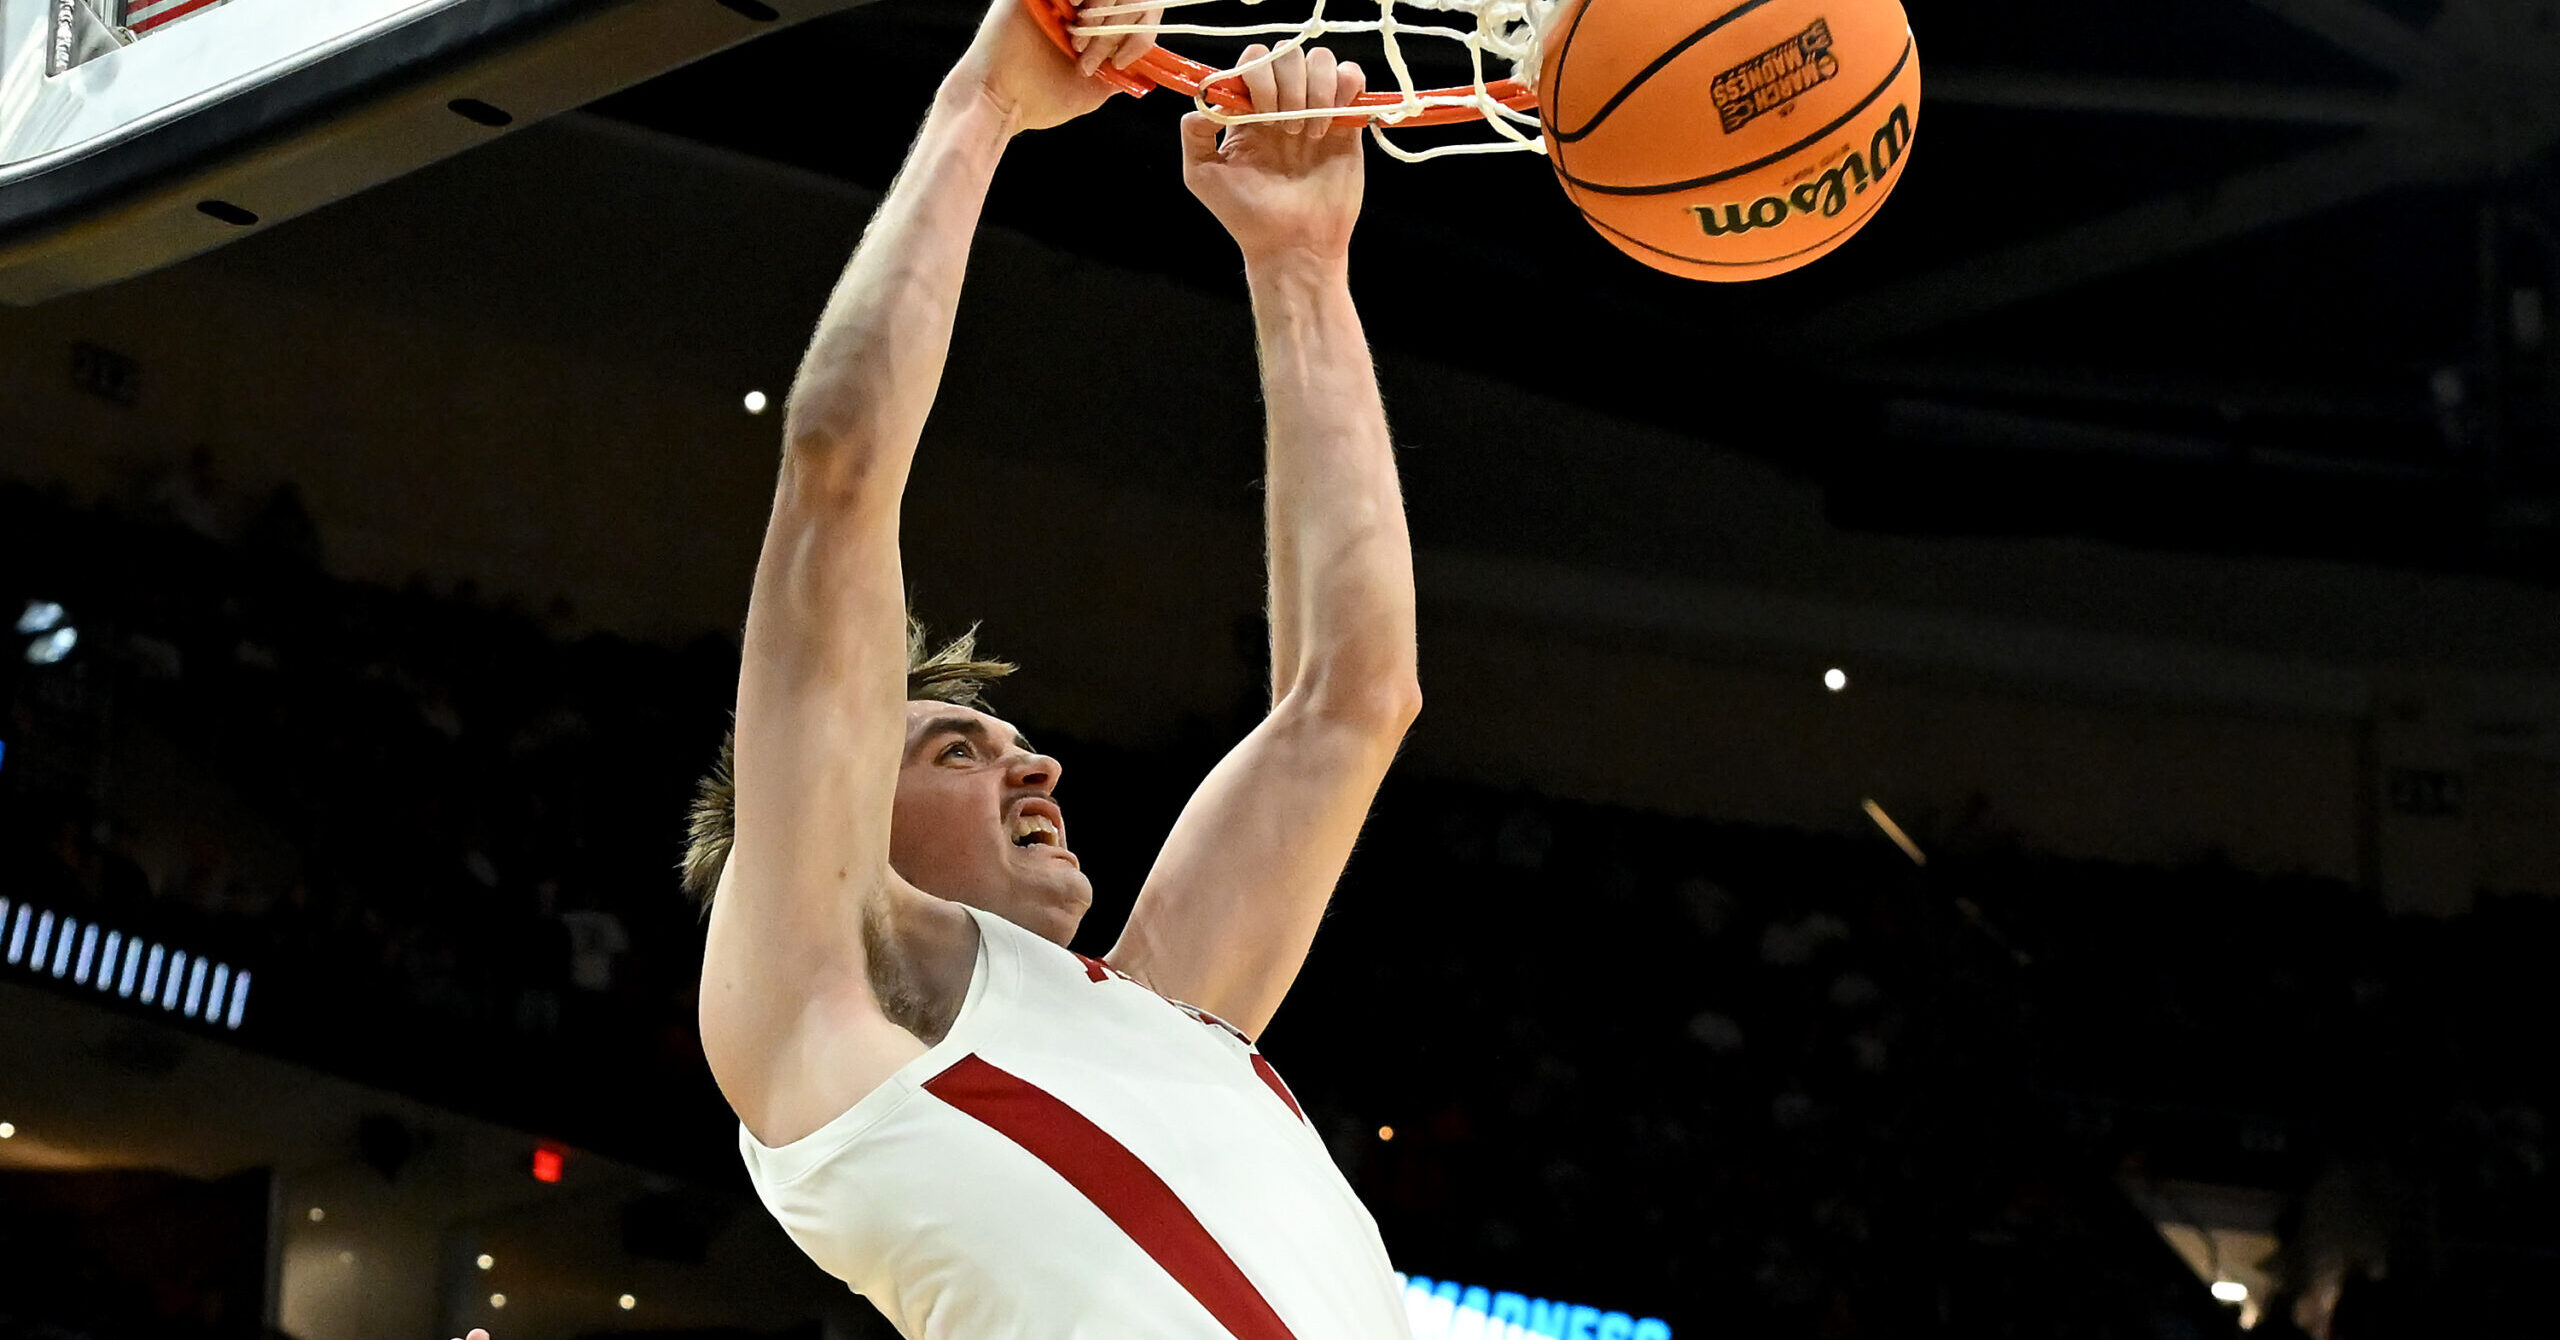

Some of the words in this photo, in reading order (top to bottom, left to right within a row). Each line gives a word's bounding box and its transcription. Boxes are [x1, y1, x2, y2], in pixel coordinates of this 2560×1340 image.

[1712, 44, 1803, 108] MADNESS
[1753, 62, 1820, 112] MARCH
[1695, 103, 1911, 236] Wilson
